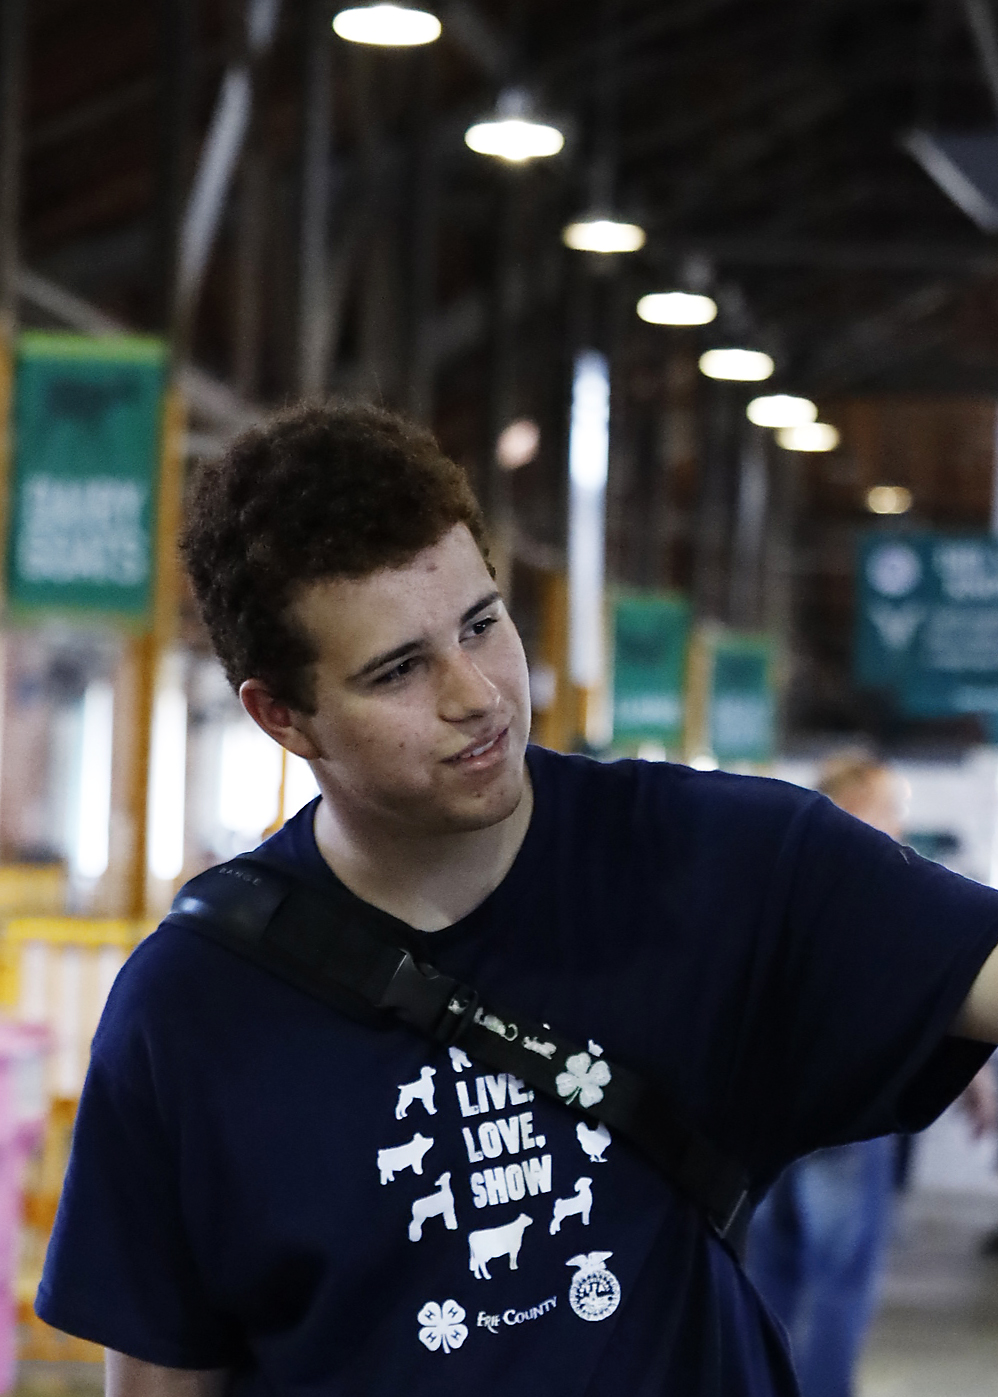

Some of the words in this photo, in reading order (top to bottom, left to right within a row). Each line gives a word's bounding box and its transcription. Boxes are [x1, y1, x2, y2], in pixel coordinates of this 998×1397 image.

[455, 1072, 535, 1118] LIVE.
[461, 1111, 546, 1163] LOVE.
[470, 1154, 552, 1209] SHOW
